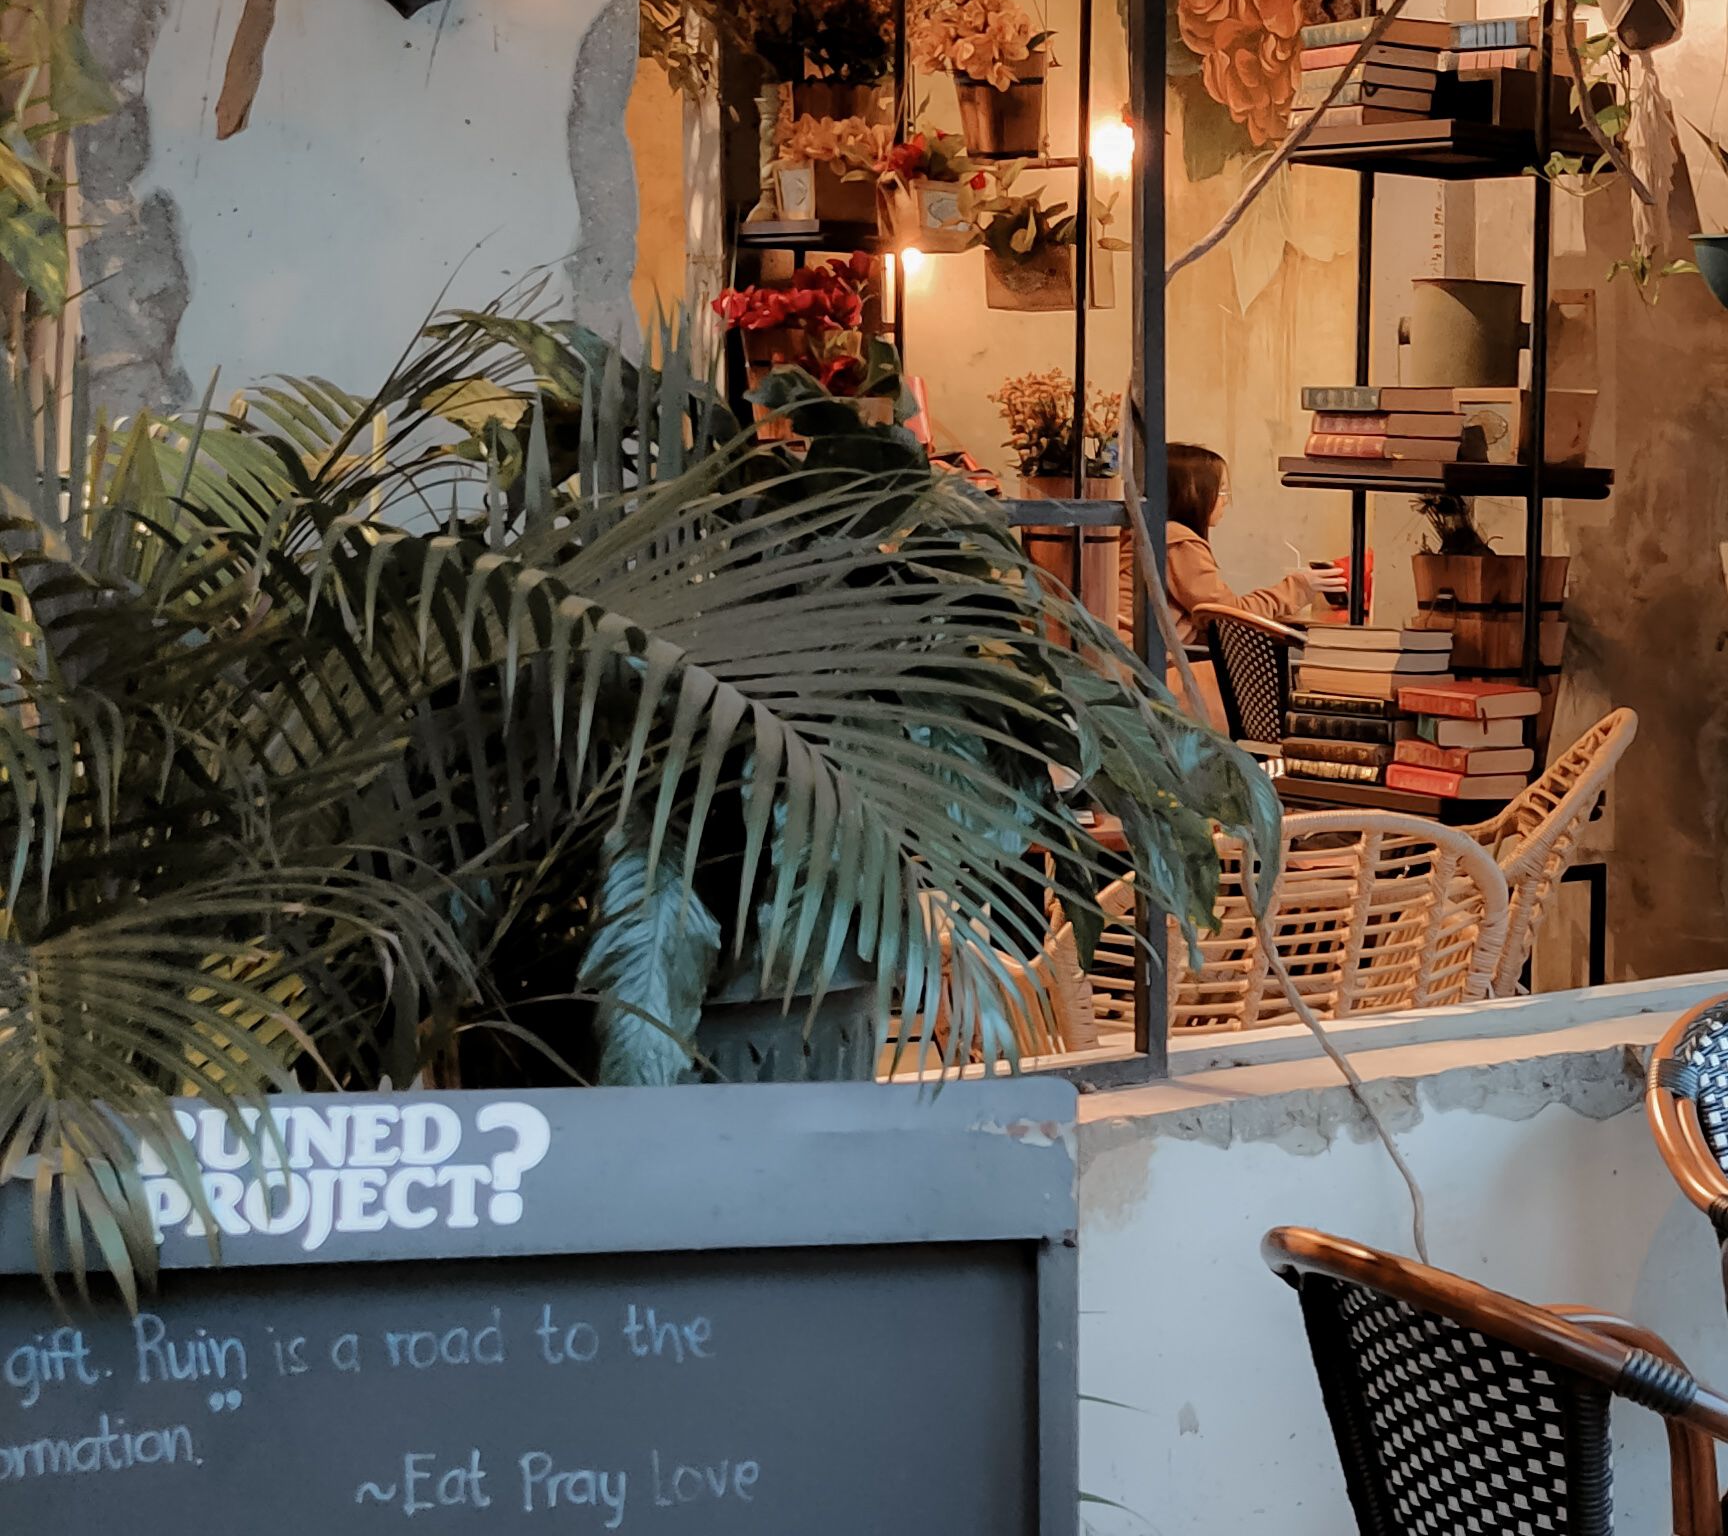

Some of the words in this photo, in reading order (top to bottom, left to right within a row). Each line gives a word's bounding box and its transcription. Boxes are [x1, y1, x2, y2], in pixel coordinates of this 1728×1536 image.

[5, 1326, 113, 1408] gift.
[133, 1313, 248, 1383] Ruin
[265, 1325, 309, 1376] is
[331, 1333, 362, 1373] a
[386, 1304, 504, 1369] road
[536, 1304, 599, 1364] to
[622, 1304, 716, 1364] the
[519, 1451, 627, 1528] Pray
[650, 1449, 760, 1507] Love
